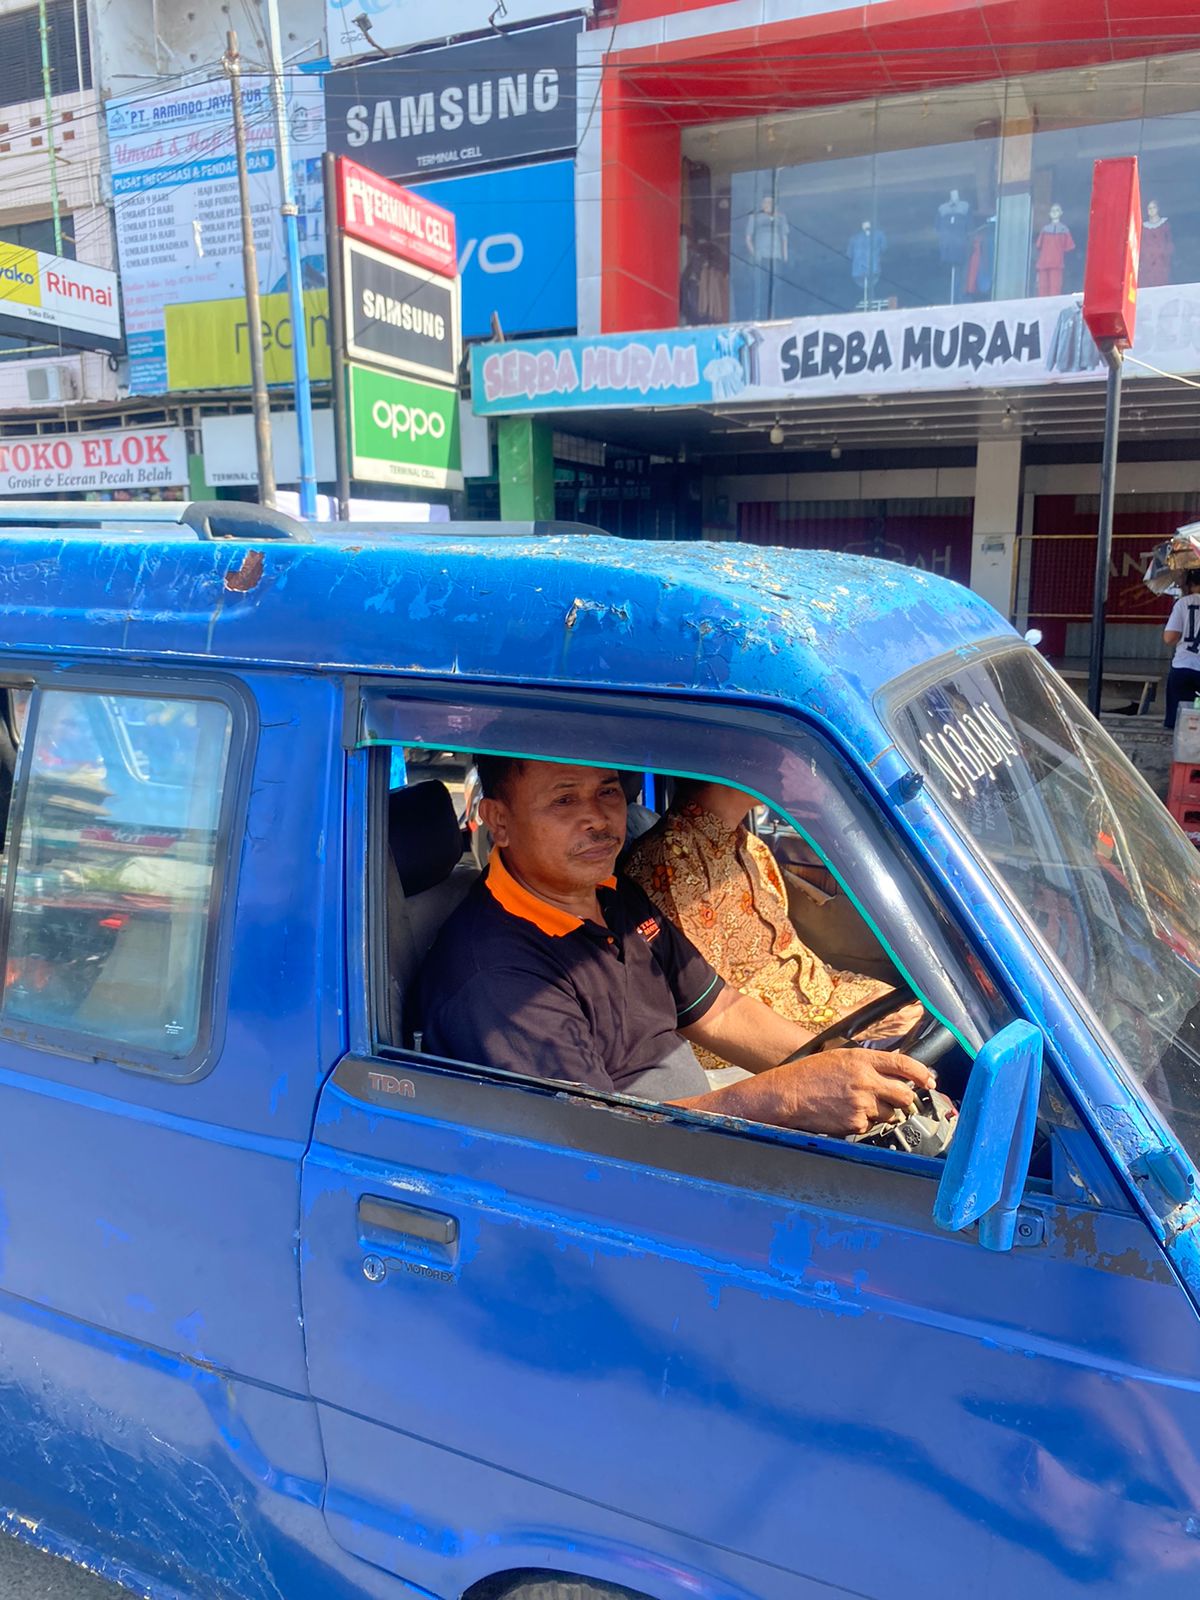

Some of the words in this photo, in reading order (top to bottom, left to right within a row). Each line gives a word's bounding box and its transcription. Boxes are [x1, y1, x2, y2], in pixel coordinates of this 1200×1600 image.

[153, 100, 202, 120] ARMINDO
[346, 68, 559, 148] SAMSUNG
[114, 175, 141, 191] PUSAT
[201, 155, 269, 177] PENDAFRAN
[416, 149, 458, 167] TERMINAL
[459, 145, 482, 159] CELL
[366, 184, 424, 238] TERMINAL
[425, 215, 452, 251] CELL
[46, 271, 113, 308] Rinnai
[362, 287, 445, 341] SAMSUNG
[780, 328, 893, 383] SERBA
[902, 319, 1041, 372] MURAH
[482, 349, 579, 402] SERBA
[581, 342, 699, 395] MURAH
[372, 400, 446, 442] oppo
[81, 434, 170, 468] ELOK
[8, 474, 41, 490] Grosir
[44, 475, 55, 488] &
[57, 471, 96, 487] Eceran
[99, 467, 134, 484] Pecah
[137, 465, 172, 482] Belah
[212, 472, 249, 481] TERMINAL
[389, 464, 420, 477] TERMINAL
[421, 469, 436, 480] CELL
[919, 701, 1019, 799] NABABAN
